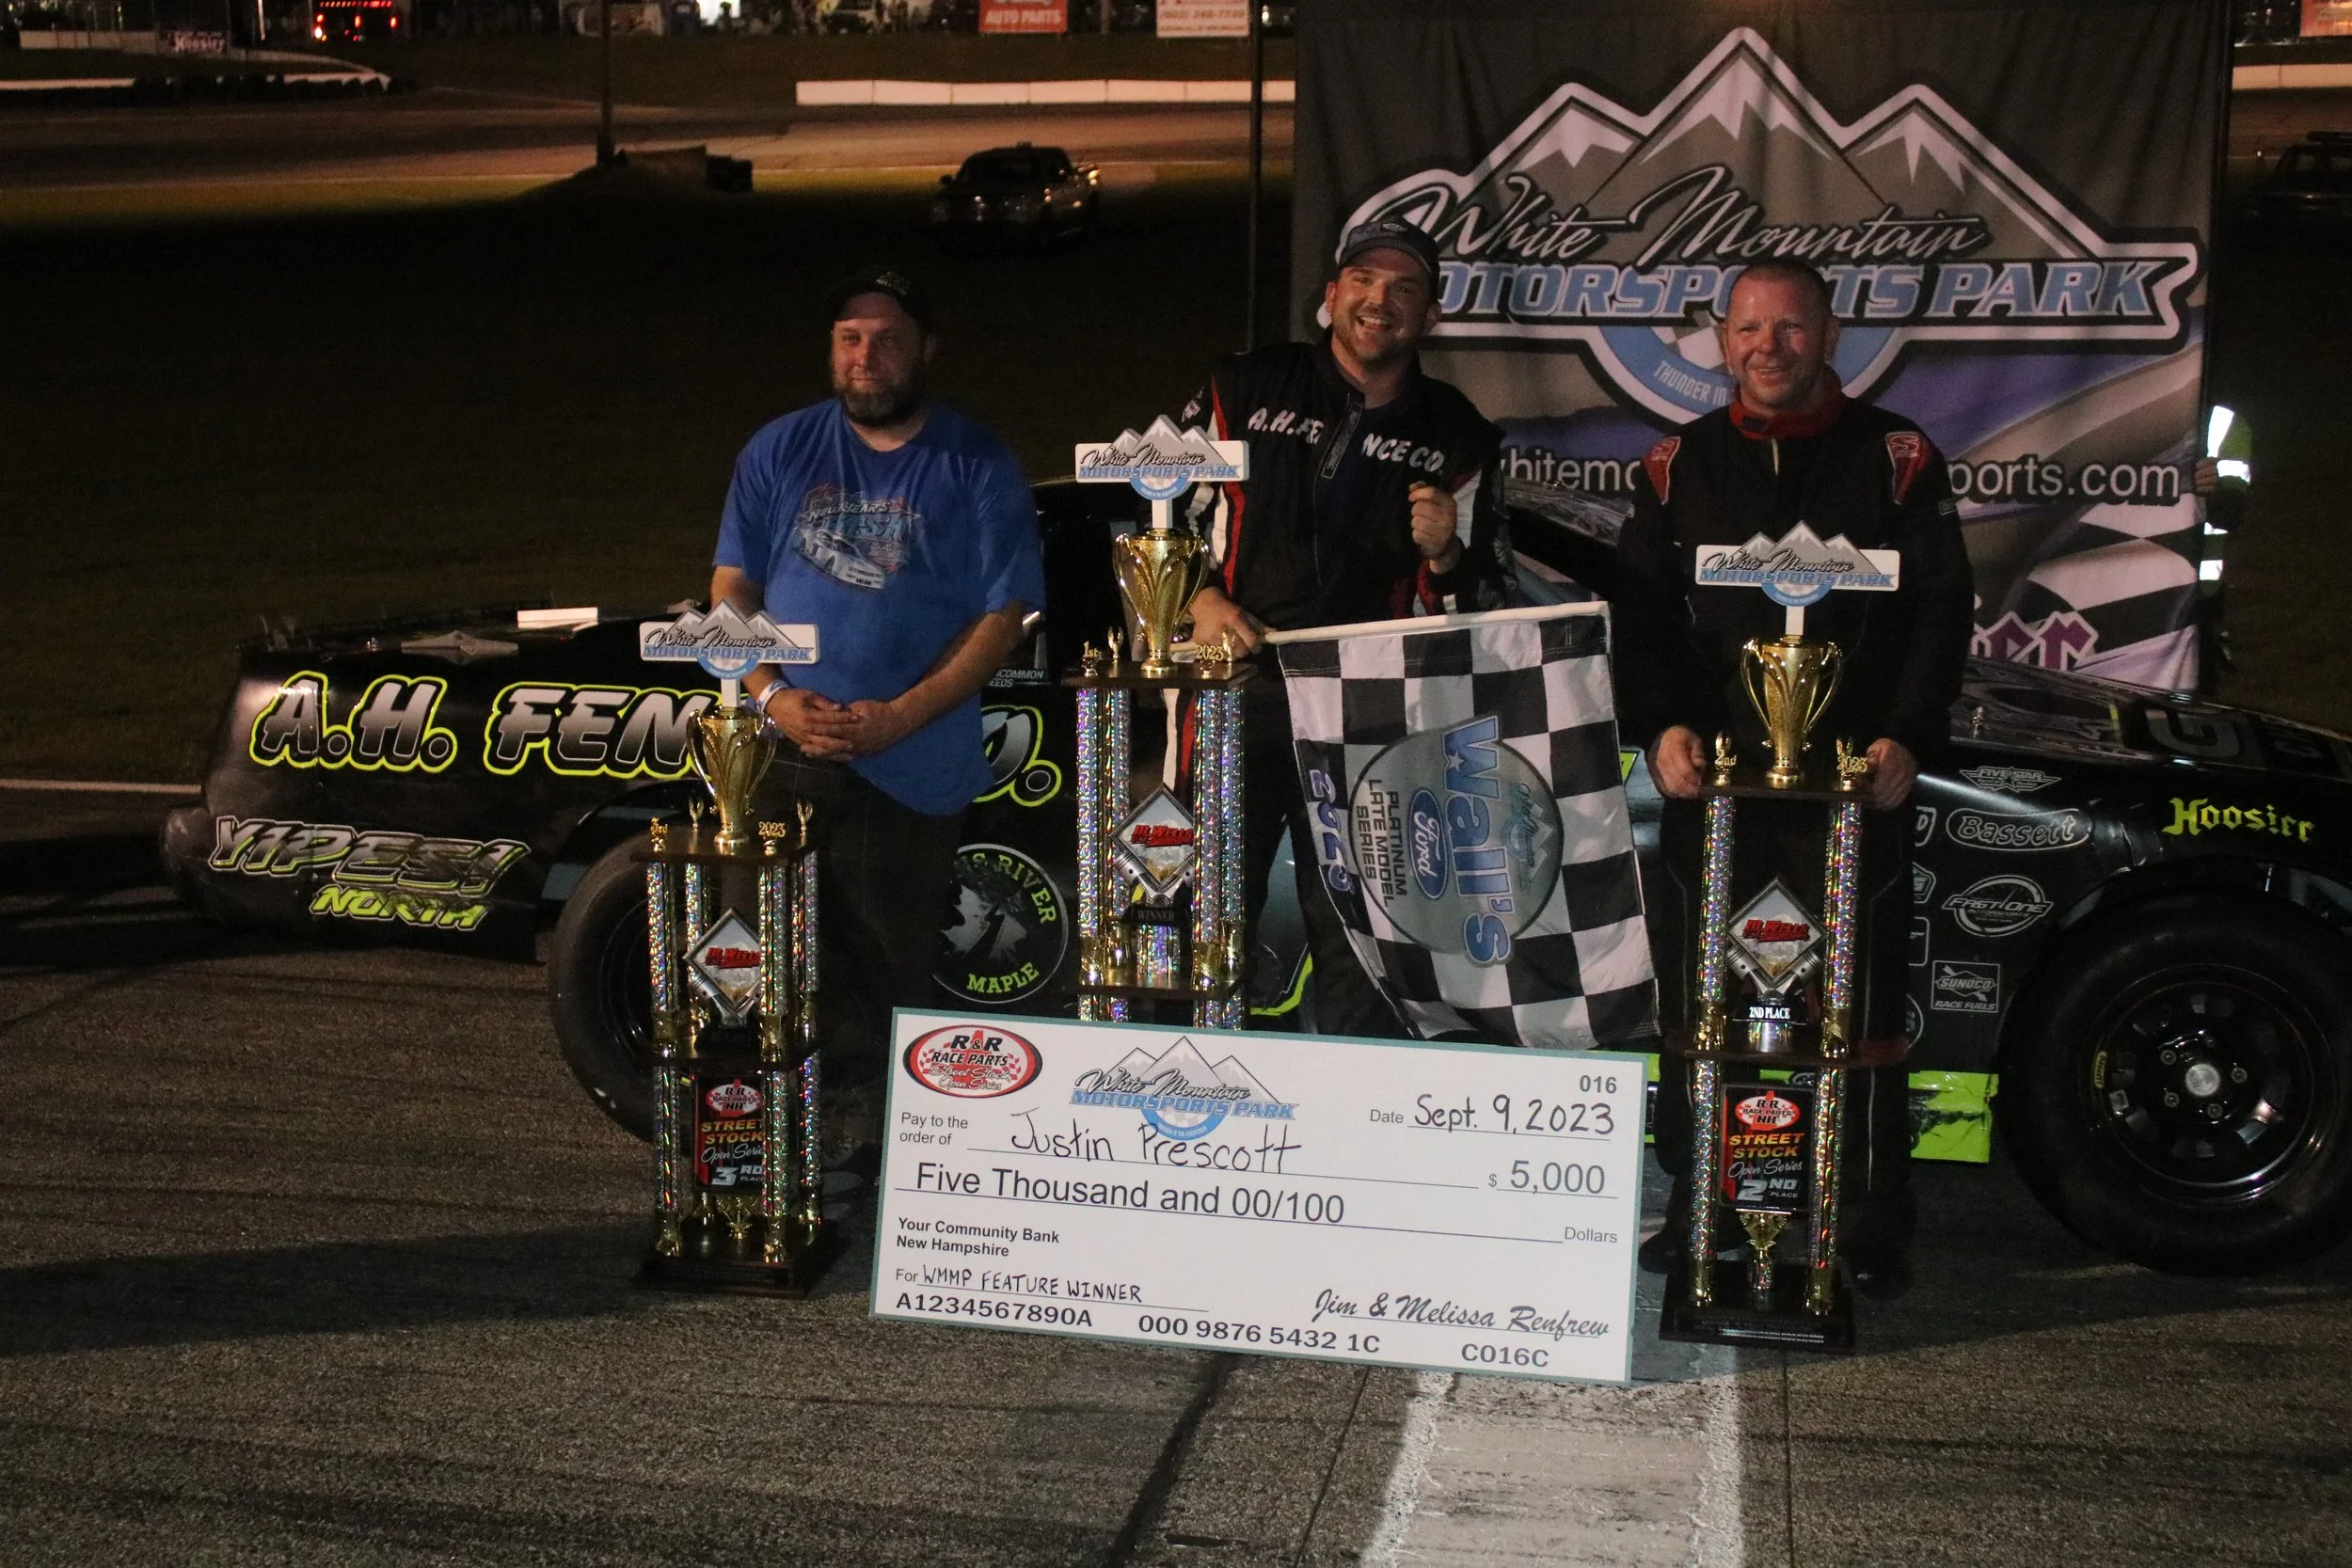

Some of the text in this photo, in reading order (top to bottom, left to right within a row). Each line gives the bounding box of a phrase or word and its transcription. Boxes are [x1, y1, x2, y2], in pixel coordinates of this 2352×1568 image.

[1370, 166, 1987, 273] White Mountain
[1923, 261, 2168, 320] PARK
[1653, 358, 1711, 404] THUNDER
[1082, 443, 1207, 468] White Mountain
[1078, 464, 1242, 481] MOTORSPORTS PARK
[1701, 548, 1856, 574] White Mountain
[1699, 567, 1897, 589] MOTORSPORTS PARK
[644, 625, 778, 649] White Mountain
[643, 643, 815, 662] MOTORSPORTS PARK
[995, 668, 1045, 679] COMMON
[255, 674, 719, 777] A.H. FEN
[1978, 768, 2010, 779] FIVE
[757, 820, 788, 838] 2023
[1957, 815, 2076, 847] Bassett
[2161, 797, 2316, 844] Hoosier
[1356, 805, 1377, 880] SERIES
[1368, 779, 1394, 908] LATE MODEL
[1386, 790, 1408, 896] PLATINUM
[1412, 810, 1441, 879] Ford
[1442, 714, 1516, 965] Wall's
[997, 853, 1057, 925] RIVER
[1947, 896, 2048, 913] FAST ONE
[965, 961, 1041, 994] MAPLE
[1939, 977, 1993, 990] SUNOCO
[1748, 1006, 1791, 1020] 2ND PLACE
[1934, 1000, 1996, 1011] RACE FUELS
[949, 1034, 1004, 1053] R&R
[929, 1063, 971, 1077] Street
[930, 1051, 1009, 1067] RACE PARTS
[937, 1075, 1003, 1093] Open Series
[1073, 1067, 1252, 1101] White Mountain
[1579, 1074, 1618, 1095] 016
[725, 1102, 744, 1111] NH
[1069, 1087, 1301, 1122] MOTORSPORTS PARK
[1413, 1092, 1480, 1133] Sept.
[900, 1112, 969, 1131] Pay to the
[1369, 1108, 1405, 1126] Date
[1756, 1115, 1777, 1124] NH
[705, 1131, 764, 1146] STOCK
[899, 1129, 953, 1147] order of
[1009, 1106, 1304, 1175] Justin Prescott
[1728, 1132, 1805, 1147] STREET
[701, 1142, 765, 1165] Open Seri
[1733, 1146, 1800, 1159] STOCK
[1487, 1159, 1607, 1196] $ 5,000
[1727, 1158, 1804, 1180] Open Series
[915, 1162, 1346, 1225] Five Thousand and 00/100
[898, 1216, 1060, 1244] Your Community Bank
[1564, 1226, 1619, 1244] Dollars
[896, 1235, 1010, 1259] New Hampshire
[895, 1267, 919, 1284] For
[922, 1263, 1144, 1305] WMMP FEATURE WINNER
[895, 1291, 1094, 1329] A1234567890A
[1311, 1287, 1610, 1342] Jim & Melissa Renfrew
[1137, 1313, 1381, 1355] 000 9876 5432 1C
[1460, 1342, 1550, 1370] C016C
